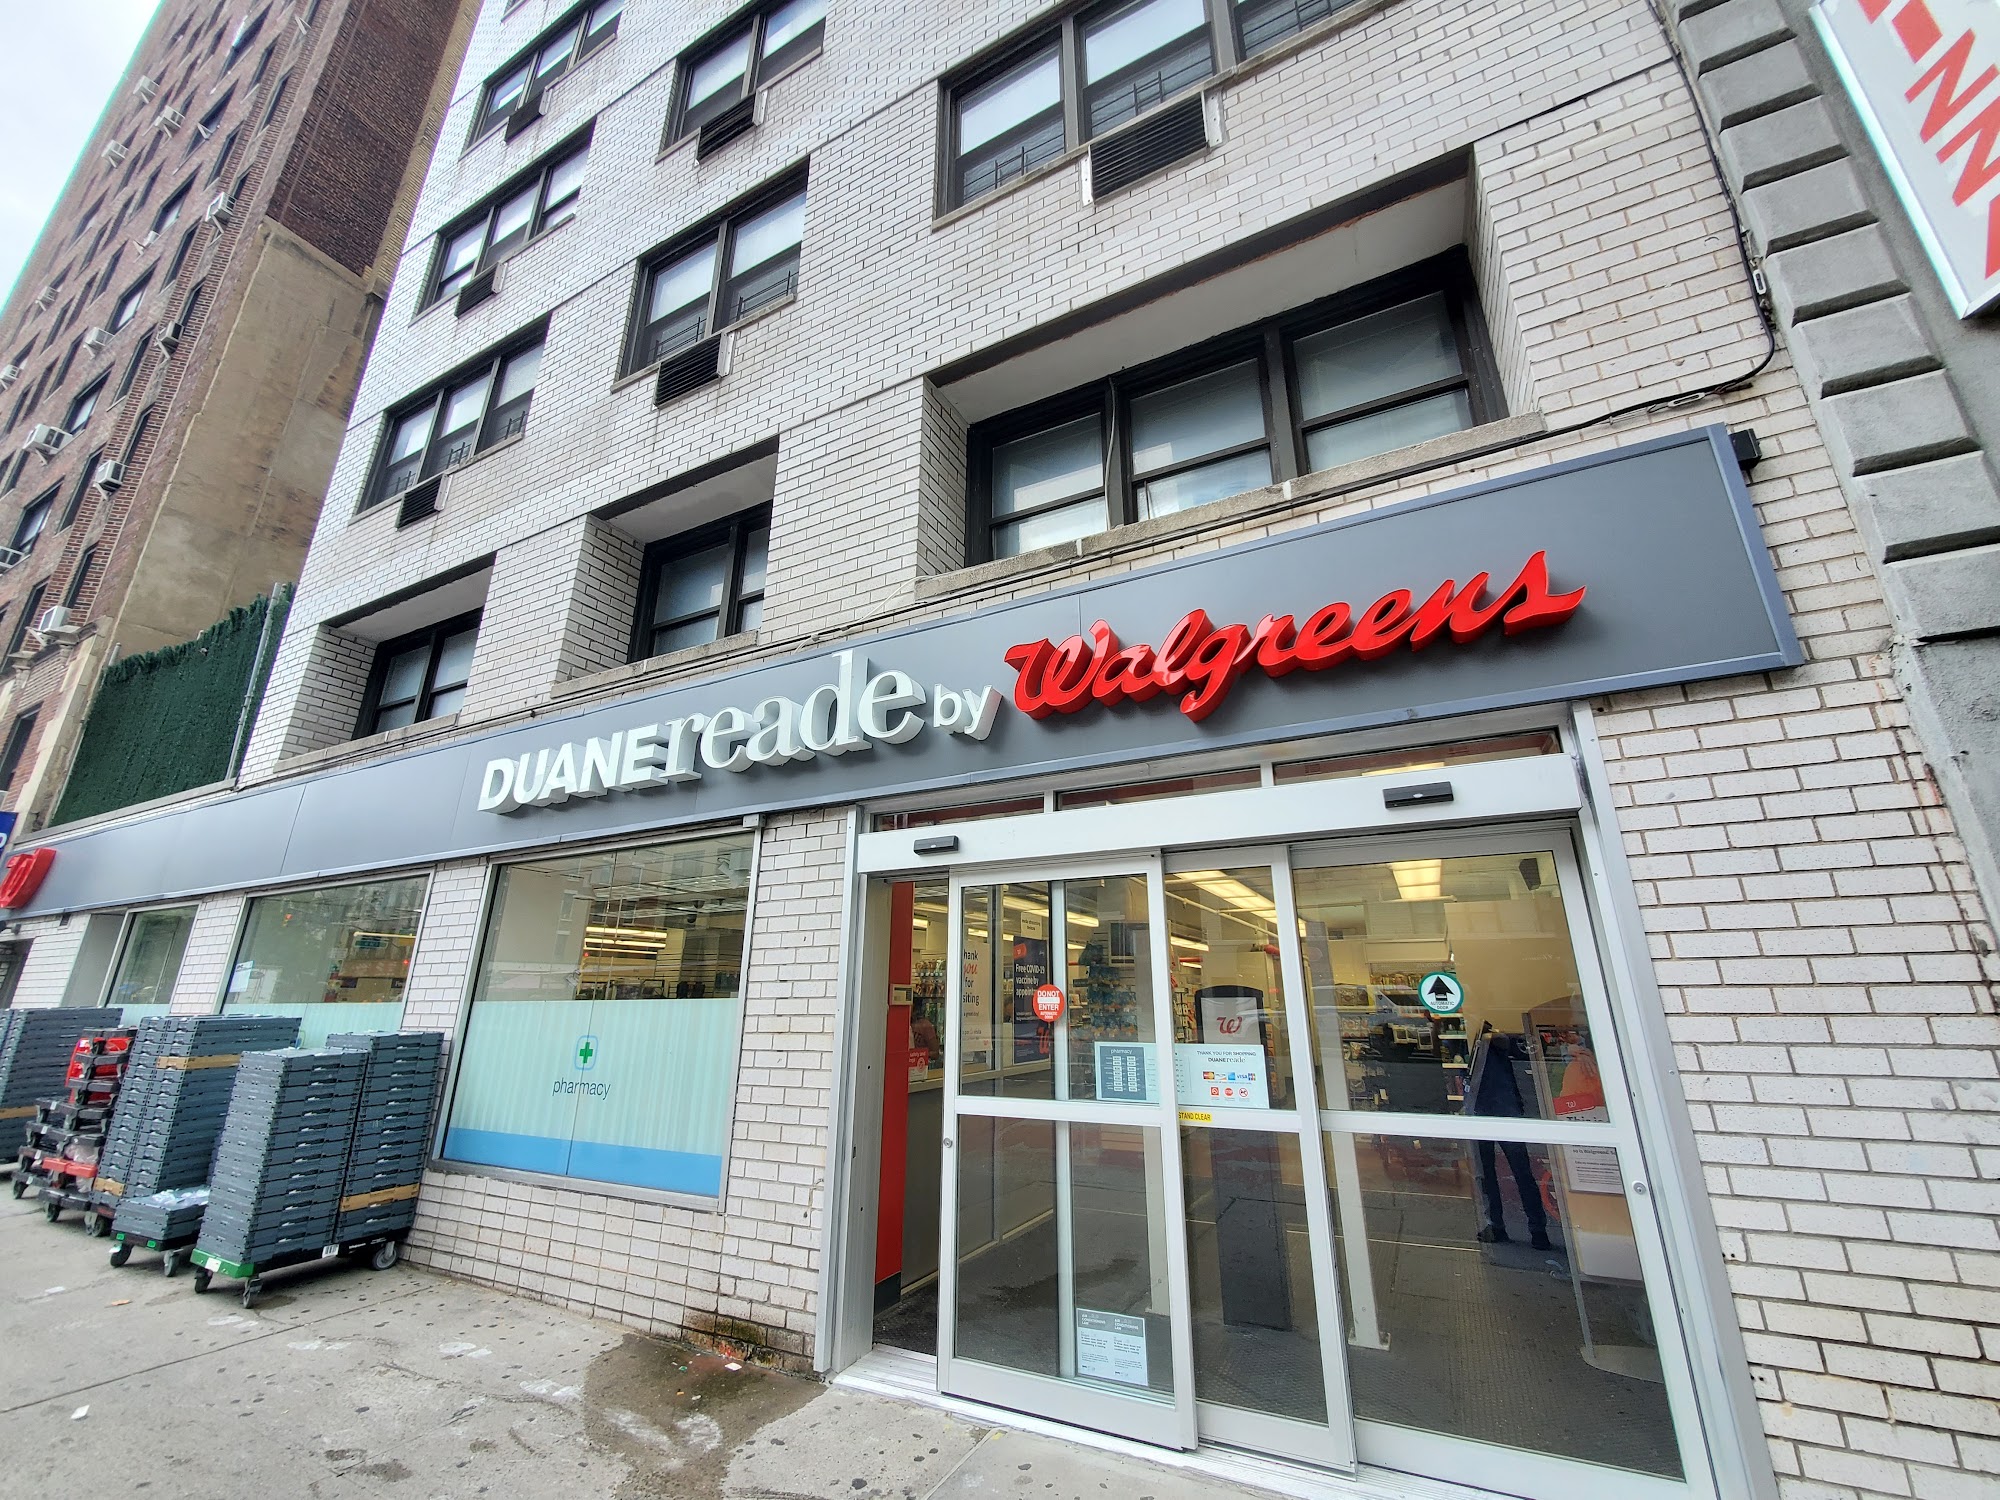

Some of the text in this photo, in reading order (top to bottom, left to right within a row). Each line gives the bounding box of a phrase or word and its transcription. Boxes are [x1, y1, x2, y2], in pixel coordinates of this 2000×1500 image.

[933, 683, 1002, 741] by
[1004, 550, 1587, 723] Walgreens
[964, 949, 978, 960] hank
[1016, 964, 1045, 974] Free COVID-19
[964, 976, 974, 987] for
[1016, 976, 1039, 987] vaccine by
[1016, 987, 1036, 997] appoint
[962, 993, 980, 1008] siting
[1038, 1003, 1059, 1011] ENTER
[552, 1077, 611, 1101] pharmacy
[1178, 1111, 1211, 1121] STAND CLEAR
